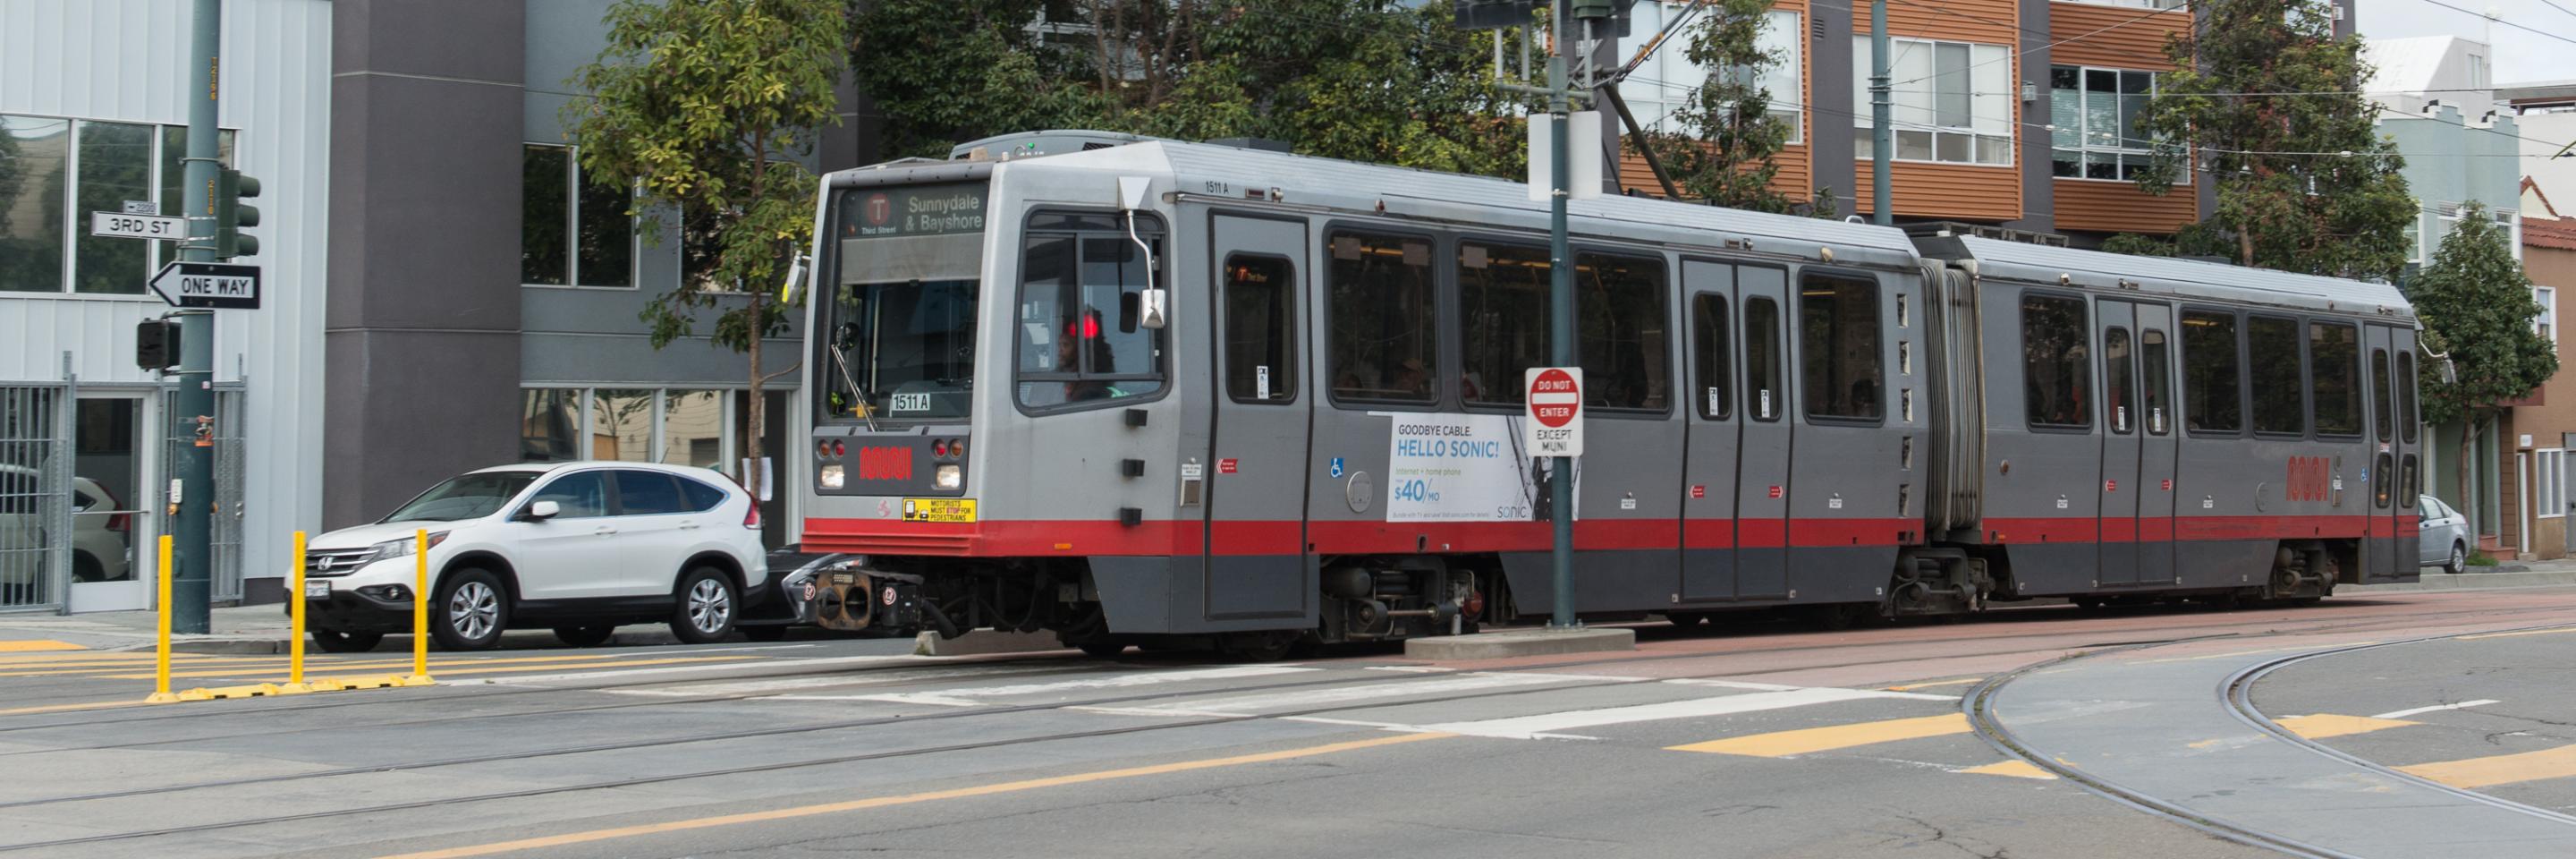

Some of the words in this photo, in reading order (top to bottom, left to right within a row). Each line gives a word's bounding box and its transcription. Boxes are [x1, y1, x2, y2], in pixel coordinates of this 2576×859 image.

[1206, 181, 1222, 193] 1511
[1223, 183, 1230, 194] A
[873, 200, 886, 220] T
[909, 194, 979, 214] Sunnydale
[110, 217, 144, 233] 3RD
[150, 220, 171, 234] ST
[905, 216, 915, 232] &
[920, 213, 982, 233] Bayshore
[182, 277, 212, 293] ONE
[217, 279, 249, 295] WAY
[1538, 381, 1551, 390] DO
[1553, 380, 1571, 390] NOT
[894, 395, 918, 410] 1511
[921, 395, 928, 409] A
[1540, 408, 1570, 417] ENTER
[1398, 424, 1441, 436] GOODBYE
[1443, 425, 1472, 437] CABLE.
[1537, 430, 1572, 439] EXCEPT
[1398, 439, 1446, 457] HELLO
[1450, 440, 1499, 458] SONIC!
[1542, 442, 1567, 451] MUNI
